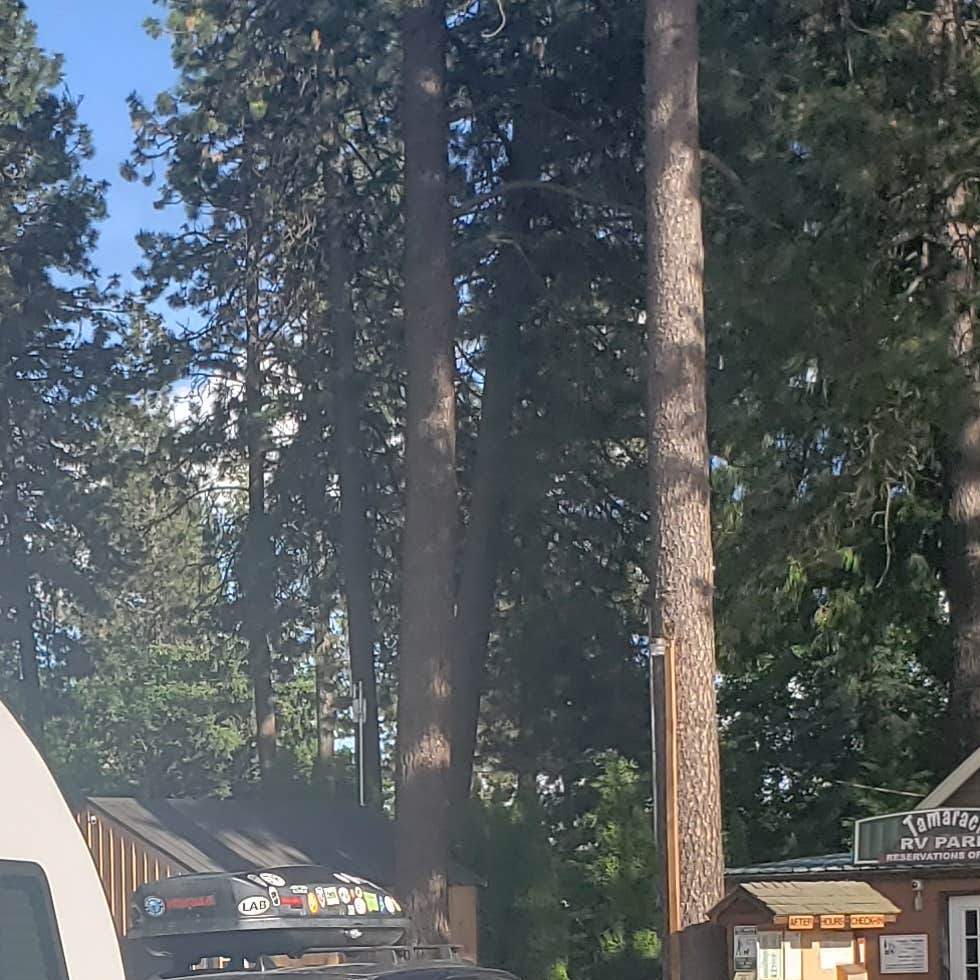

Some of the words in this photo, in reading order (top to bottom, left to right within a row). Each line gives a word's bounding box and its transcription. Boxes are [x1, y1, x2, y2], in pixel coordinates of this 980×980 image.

[901, 836, 928, 850] RV
[886, 851, 965, 862] RESERVATIONS
[242, 900, 267, 912] LAB
[790, 917, 811, 927] AFTER
